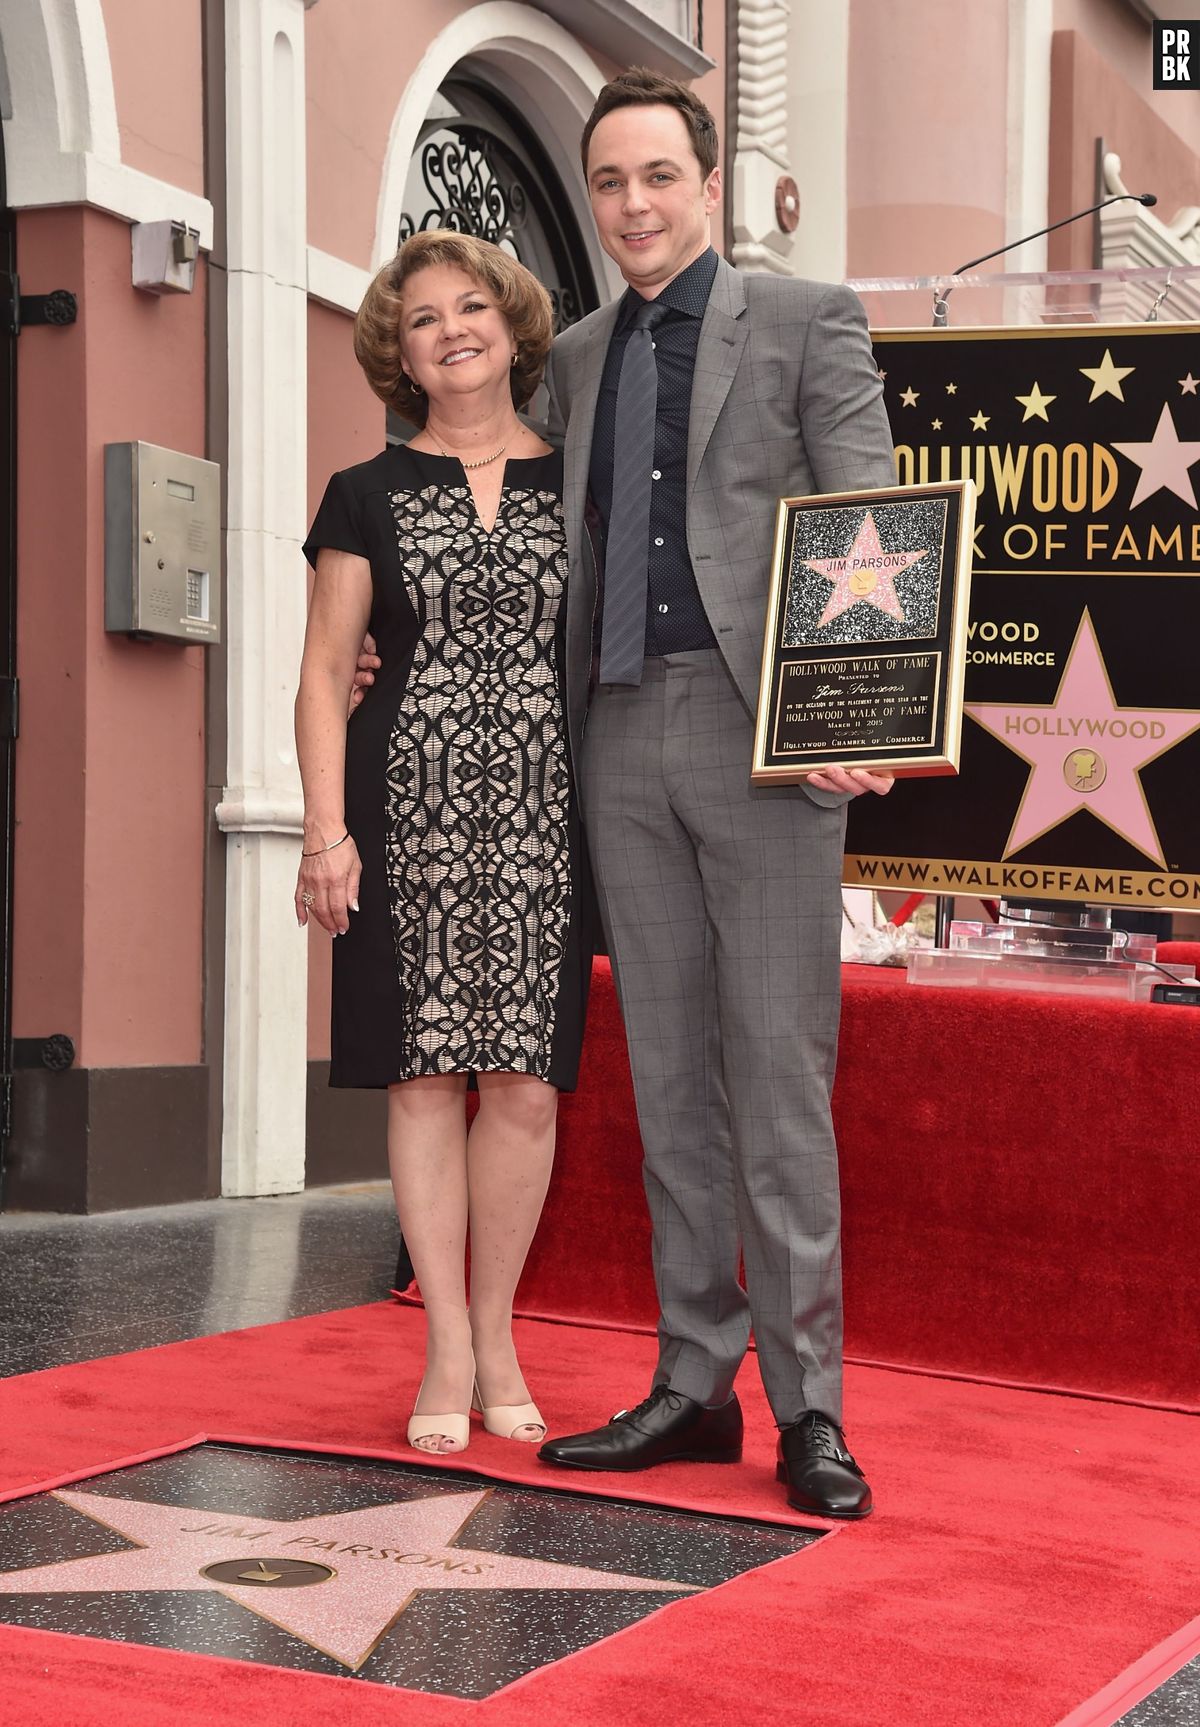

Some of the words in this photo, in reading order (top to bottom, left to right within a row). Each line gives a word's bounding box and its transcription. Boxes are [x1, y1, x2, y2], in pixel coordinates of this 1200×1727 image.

[894, 442, 1118, 515] OLLYWOOD
[1003, 524, 1067, 560] OF
[826, 560, 847, 572] JIM
[852, 555, 907, 570] PARSONS
[789, 662, 847, 677] HOLLYWOOD
[852, 659, 880, 673] WALK
[886, 659, 899, 670] OF
[903, 657, 930, 669] FAME
[811, 684, 843, 700] Jim
[846, 682, 905, 695] Parsons
[785, 711, 843, 723] HOLLYWOOD
[849, 708, 877, 719] WALK
[883, 707, 895, 716] OF
[900, 705, 928, 715] FAME
[1004, 715, 1166, 740] HOLLYWOOD
[180, 1523, 272, 1541] JIM
[283, 1536, 494, 1575] PARSONS
